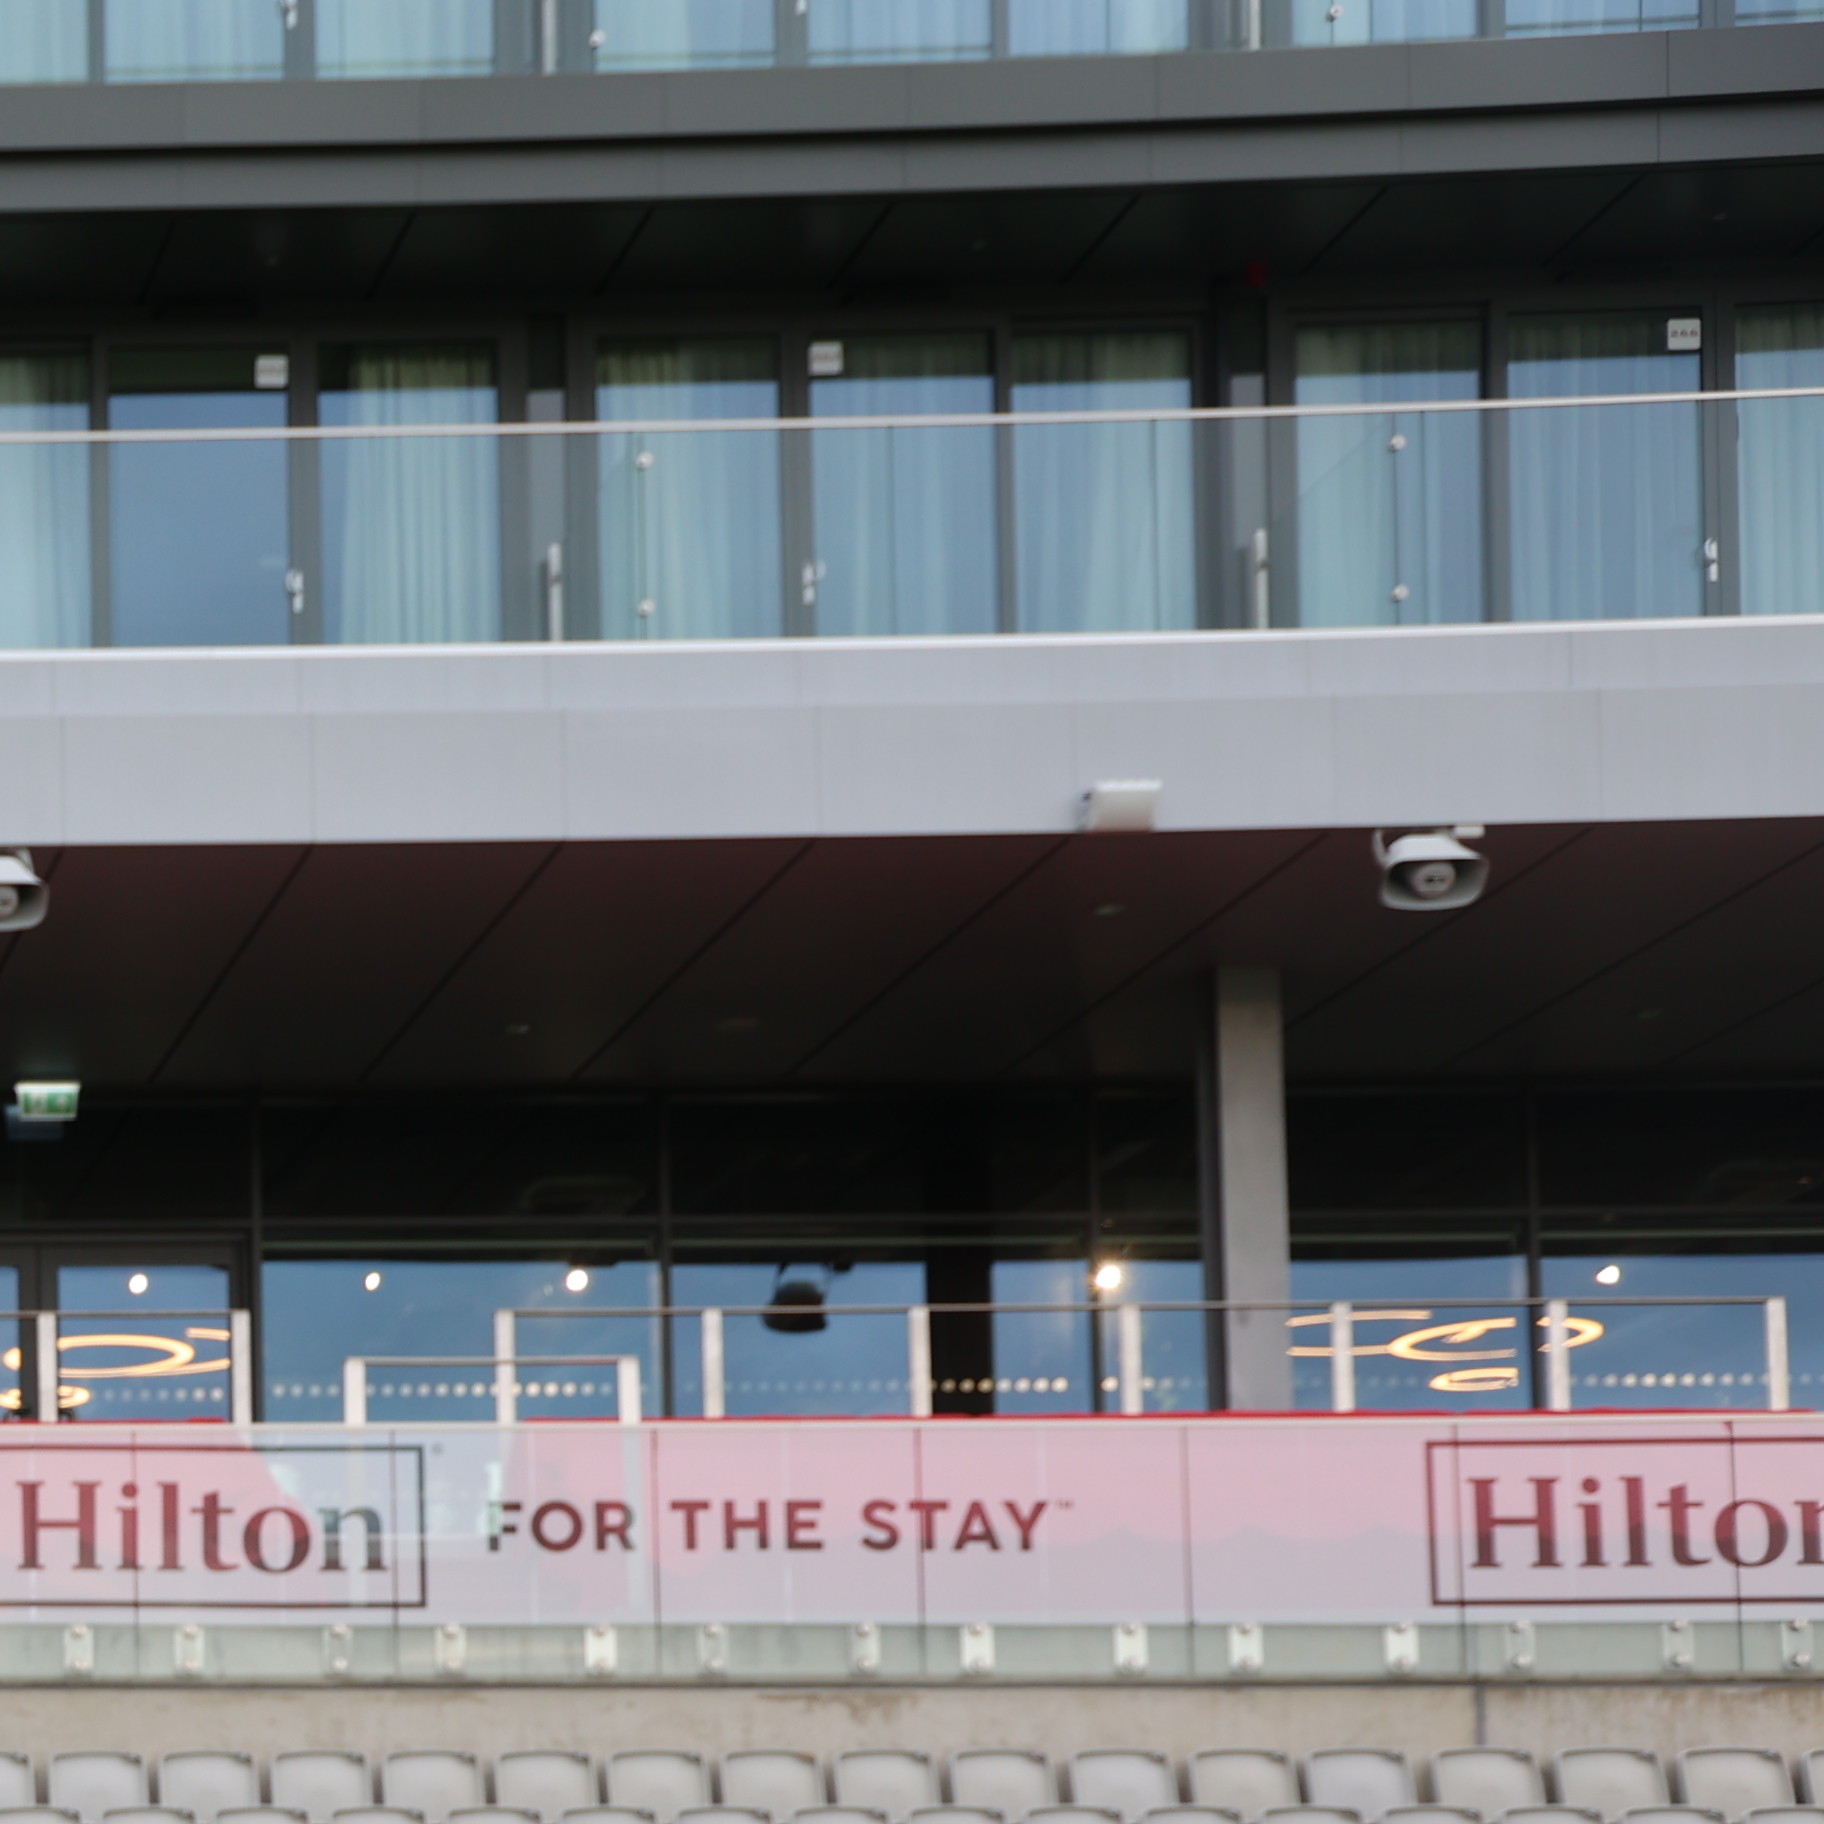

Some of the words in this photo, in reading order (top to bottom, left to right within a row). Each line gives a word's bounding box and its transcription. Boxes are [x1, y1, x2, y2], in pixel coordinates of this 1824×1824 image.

[15, 1480, 388, 1574] Hilton
[487, 1500, 636, 1552] FOR
[670, 1499, 823, 1551] THE
